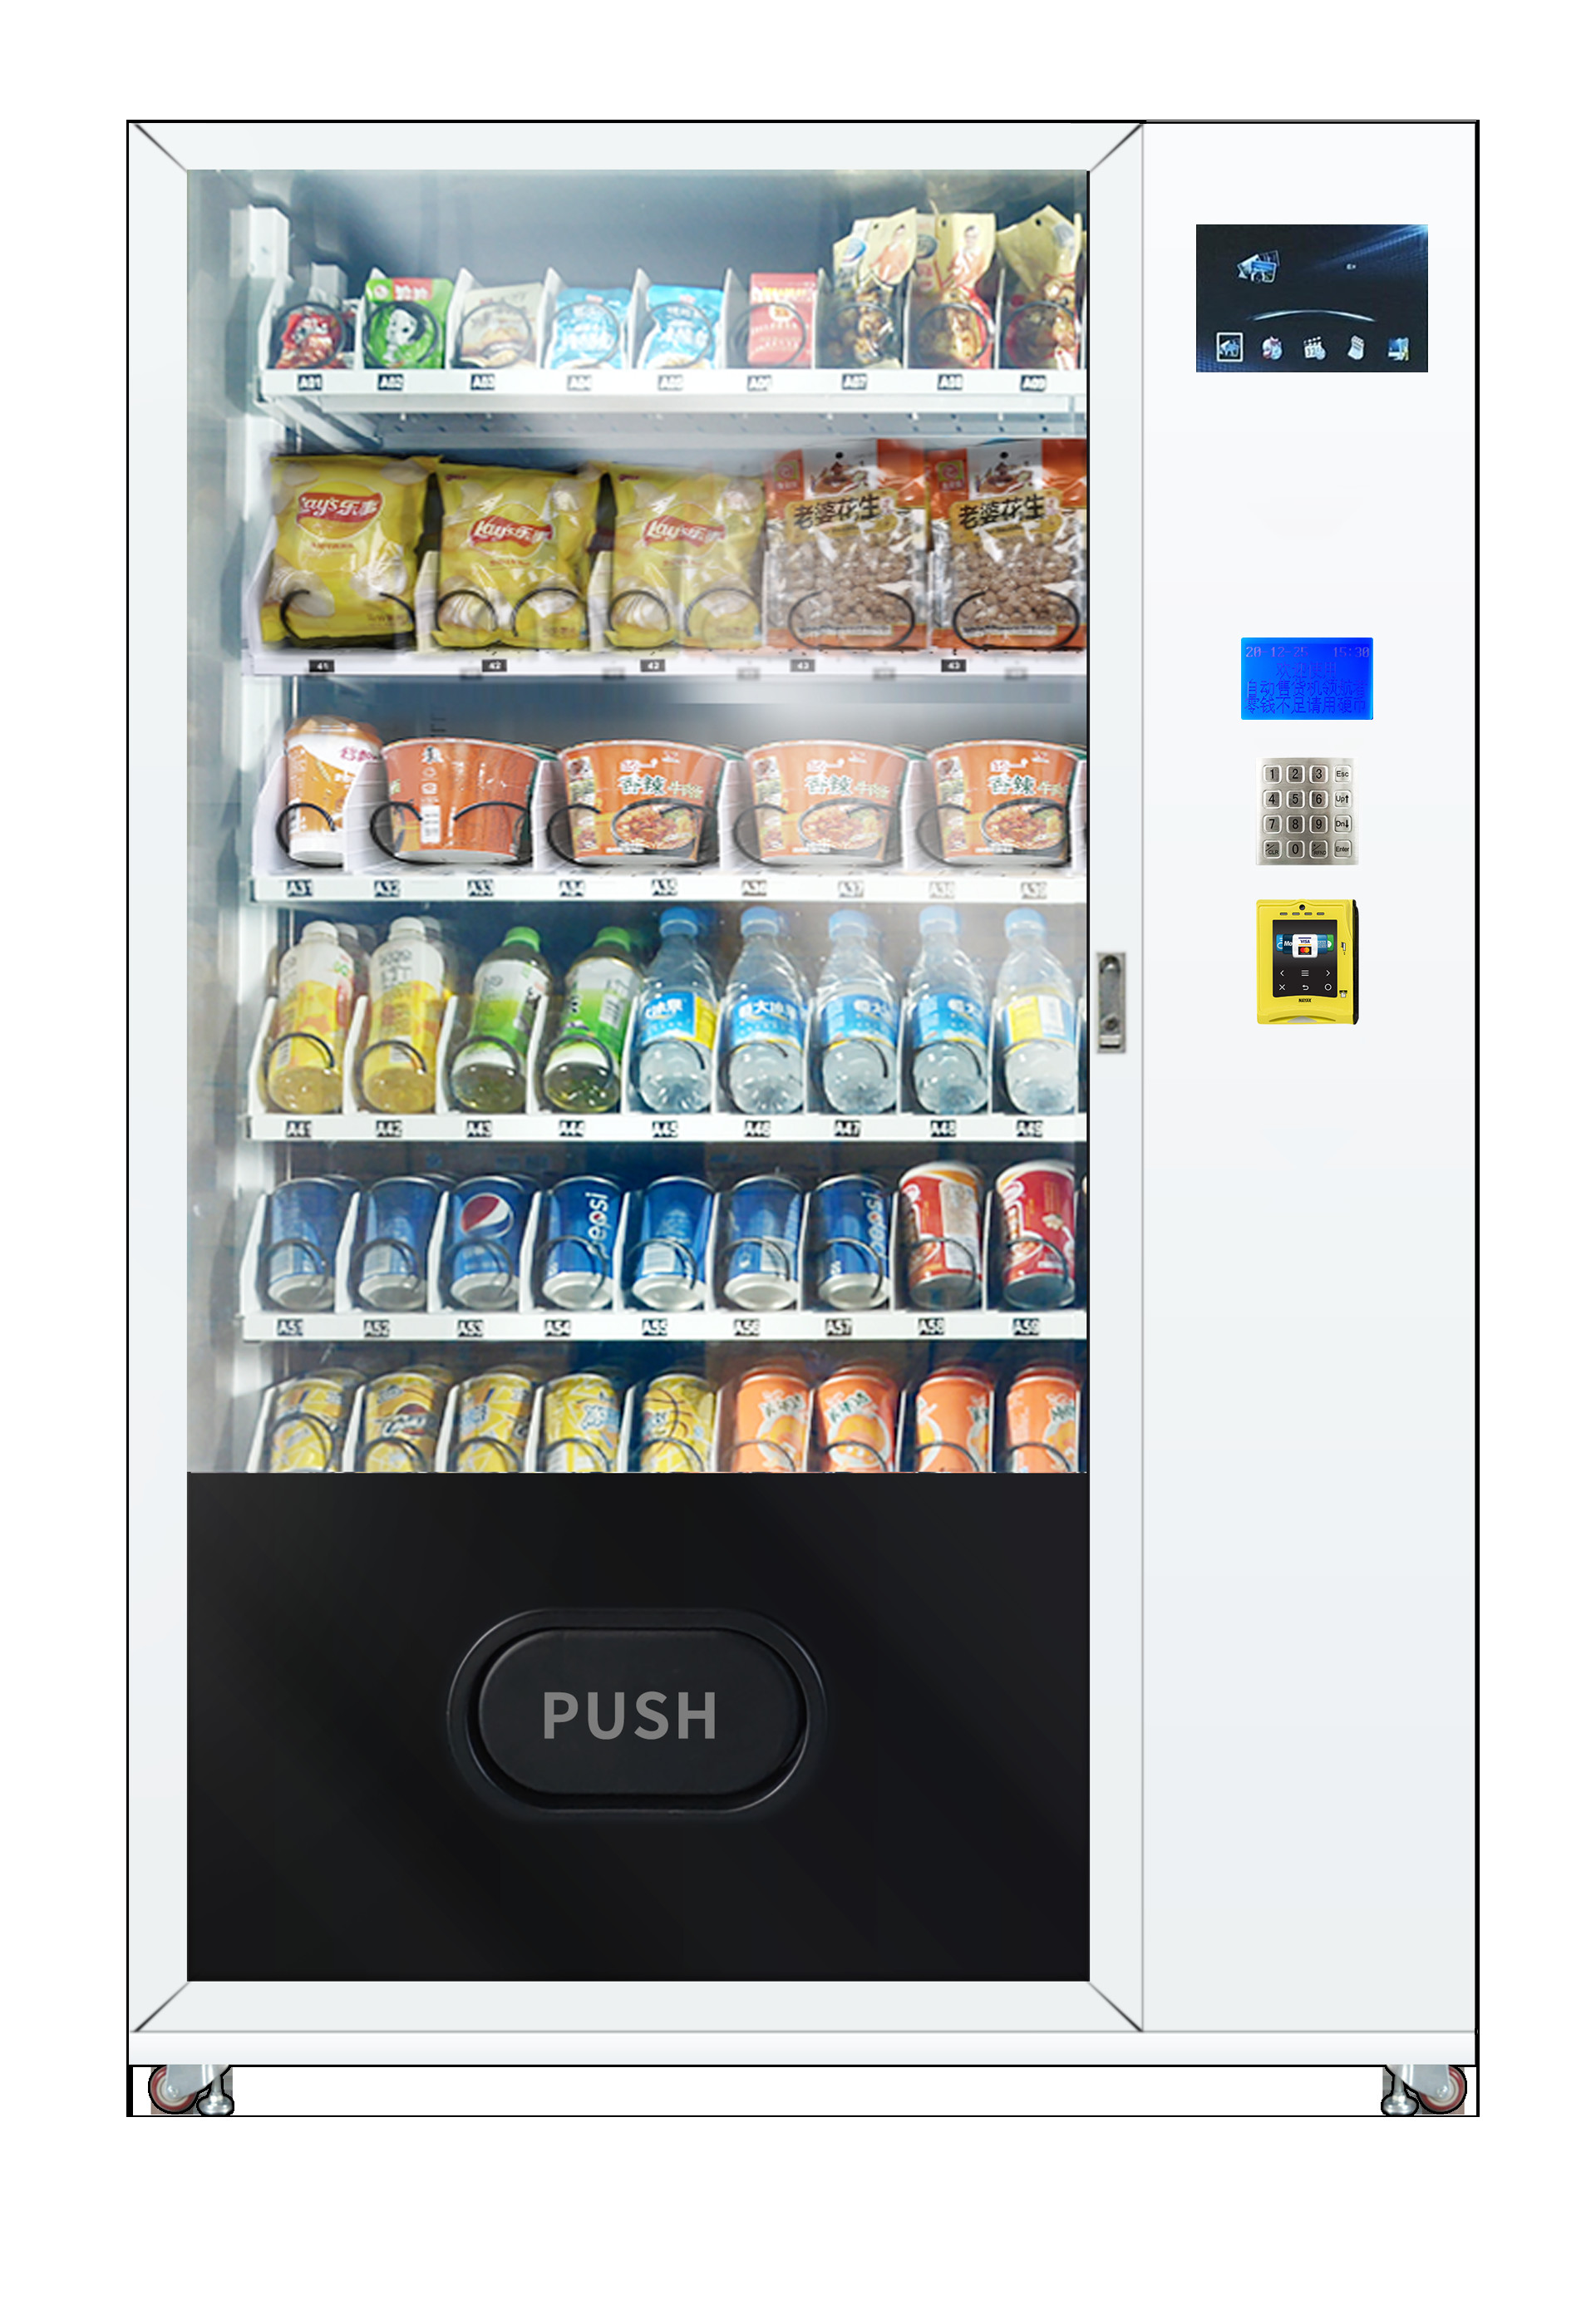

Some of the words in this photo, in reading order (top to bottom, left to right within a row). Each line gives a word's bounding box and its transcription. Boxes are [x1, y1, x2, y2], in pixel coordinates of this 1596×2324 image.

[298, 374, 323, 391] A01
[377, 374, 403, 391] A02
[795, 494, 880, 529] 老婆花生
[959, 495, 1046, 530] 老婆花生
[1245, 647, 1308, 657] 20-12-25
[1333, 647, 1370, 657] 15:30
[1276, 661, 1337, 679] 欢迎使用
[1244, 697, 1367, 714] 零钱不足请用硬币
[1269, 769, 1274, 779] 1
[1292, 769, 1298, 779] 2
[1316, 769, 1323, 779] 3
[1268, 794, 1275, 804] 4
[1292, 794, 1298, 804] 5
[1316, 794, 1323, 804] 6
[1268, 819, 1275, 829] 7
[1292, 819, 1298, 829] 8
[1316, 819, 1323, 829] 9
[1292, 844, 1298, 854] 0
[544, 1691, 716, 1741] PUSH
